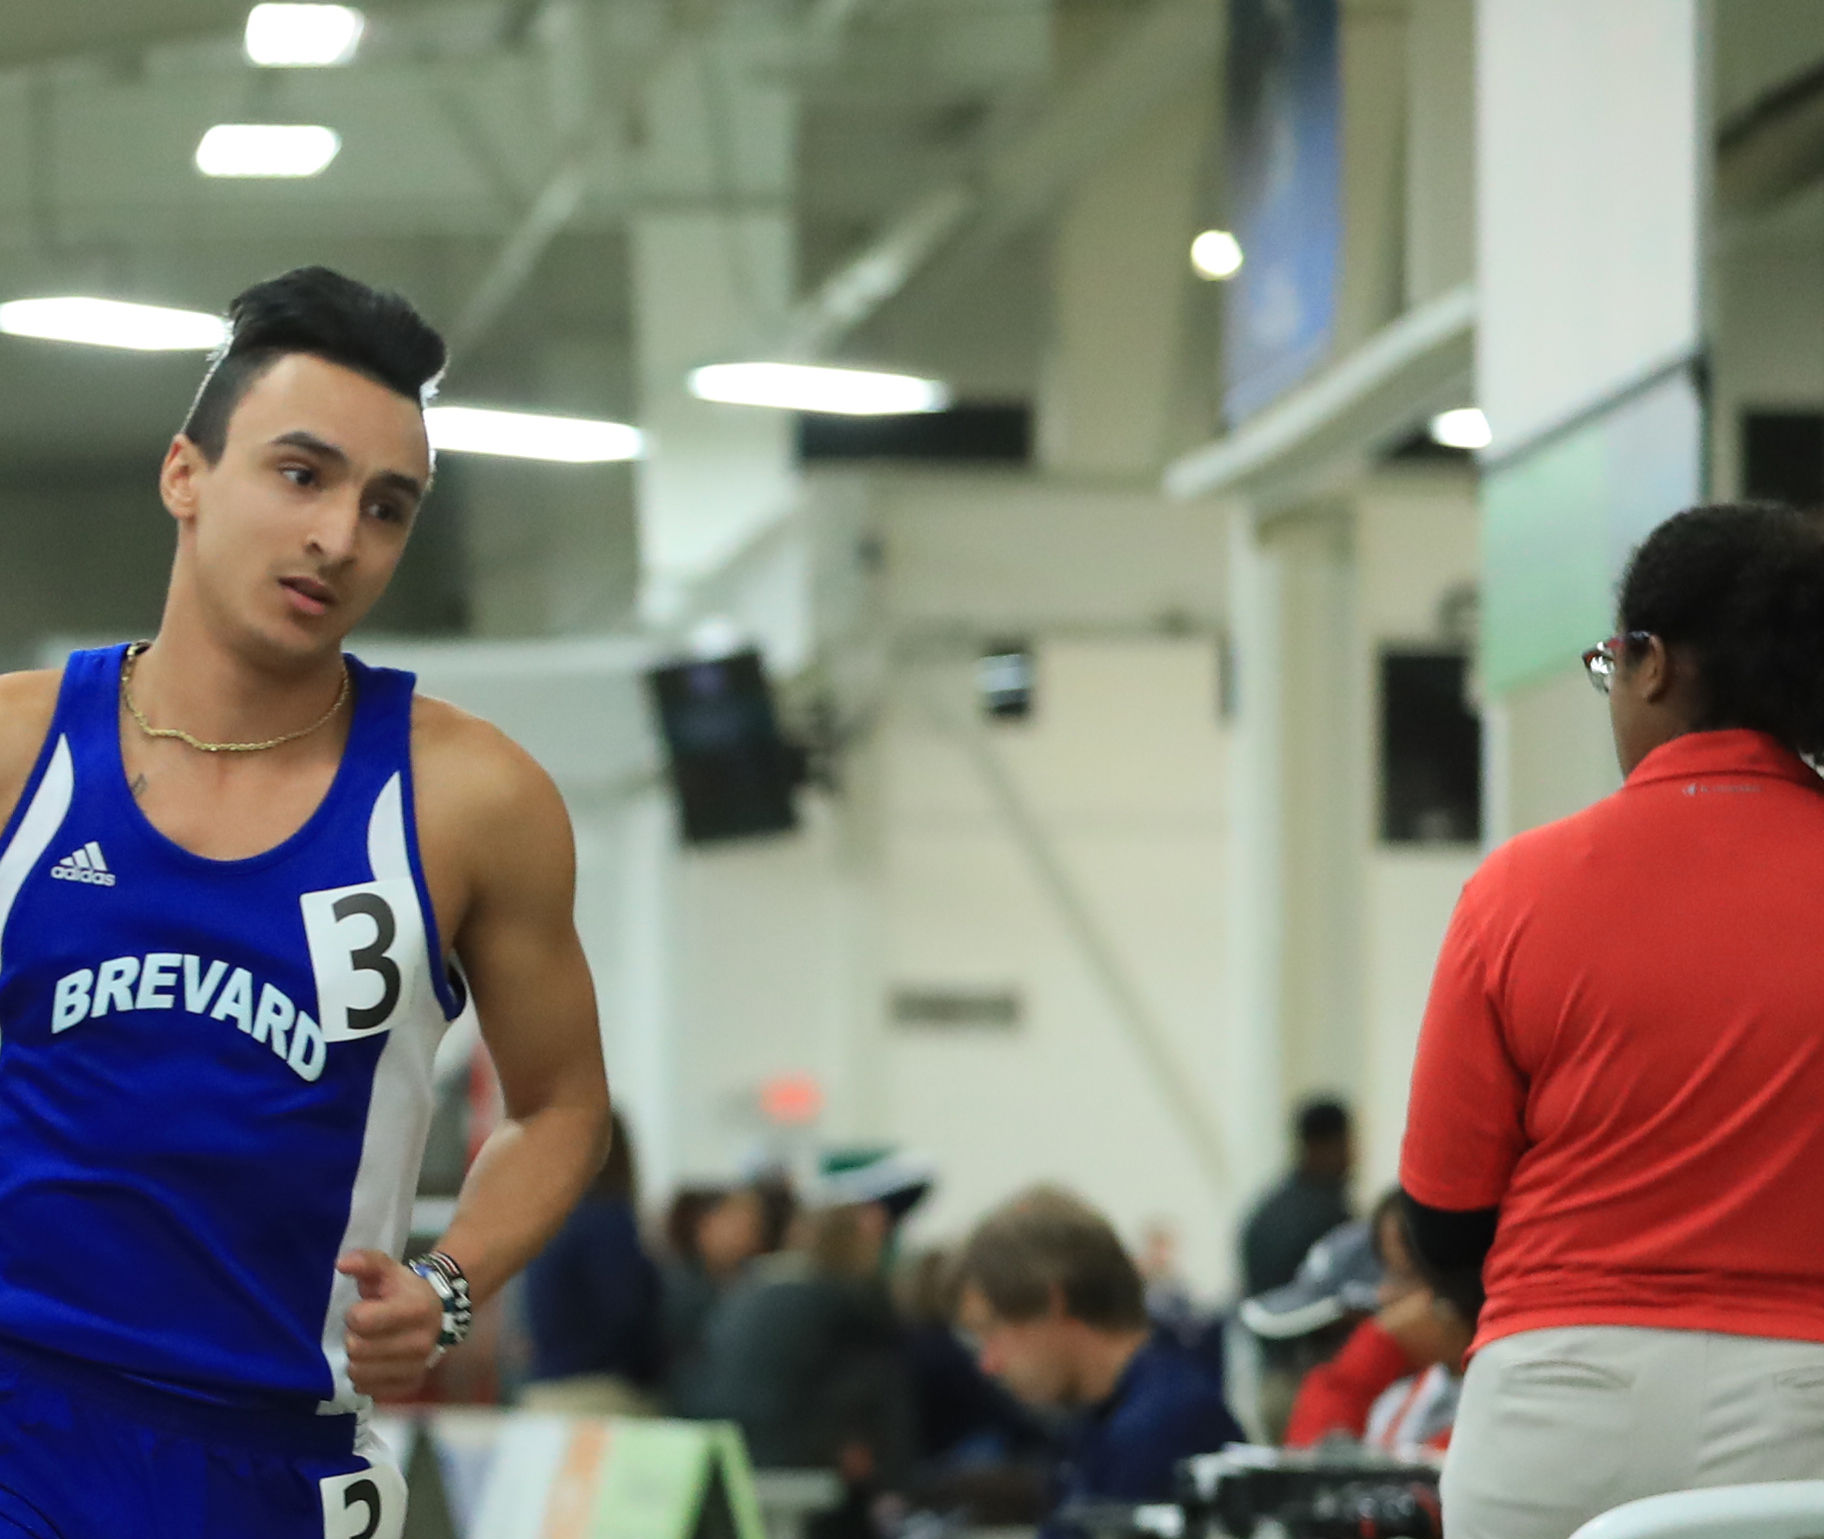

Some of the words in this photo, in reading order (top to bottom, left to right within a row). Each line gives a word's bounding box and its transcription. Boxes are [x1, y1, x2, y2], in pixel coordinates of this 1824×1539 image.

[50, 866, 116, 888] adidas
[51, 952, 327, 1083] BREVARD
[332, 892, 401, 1030] 3
